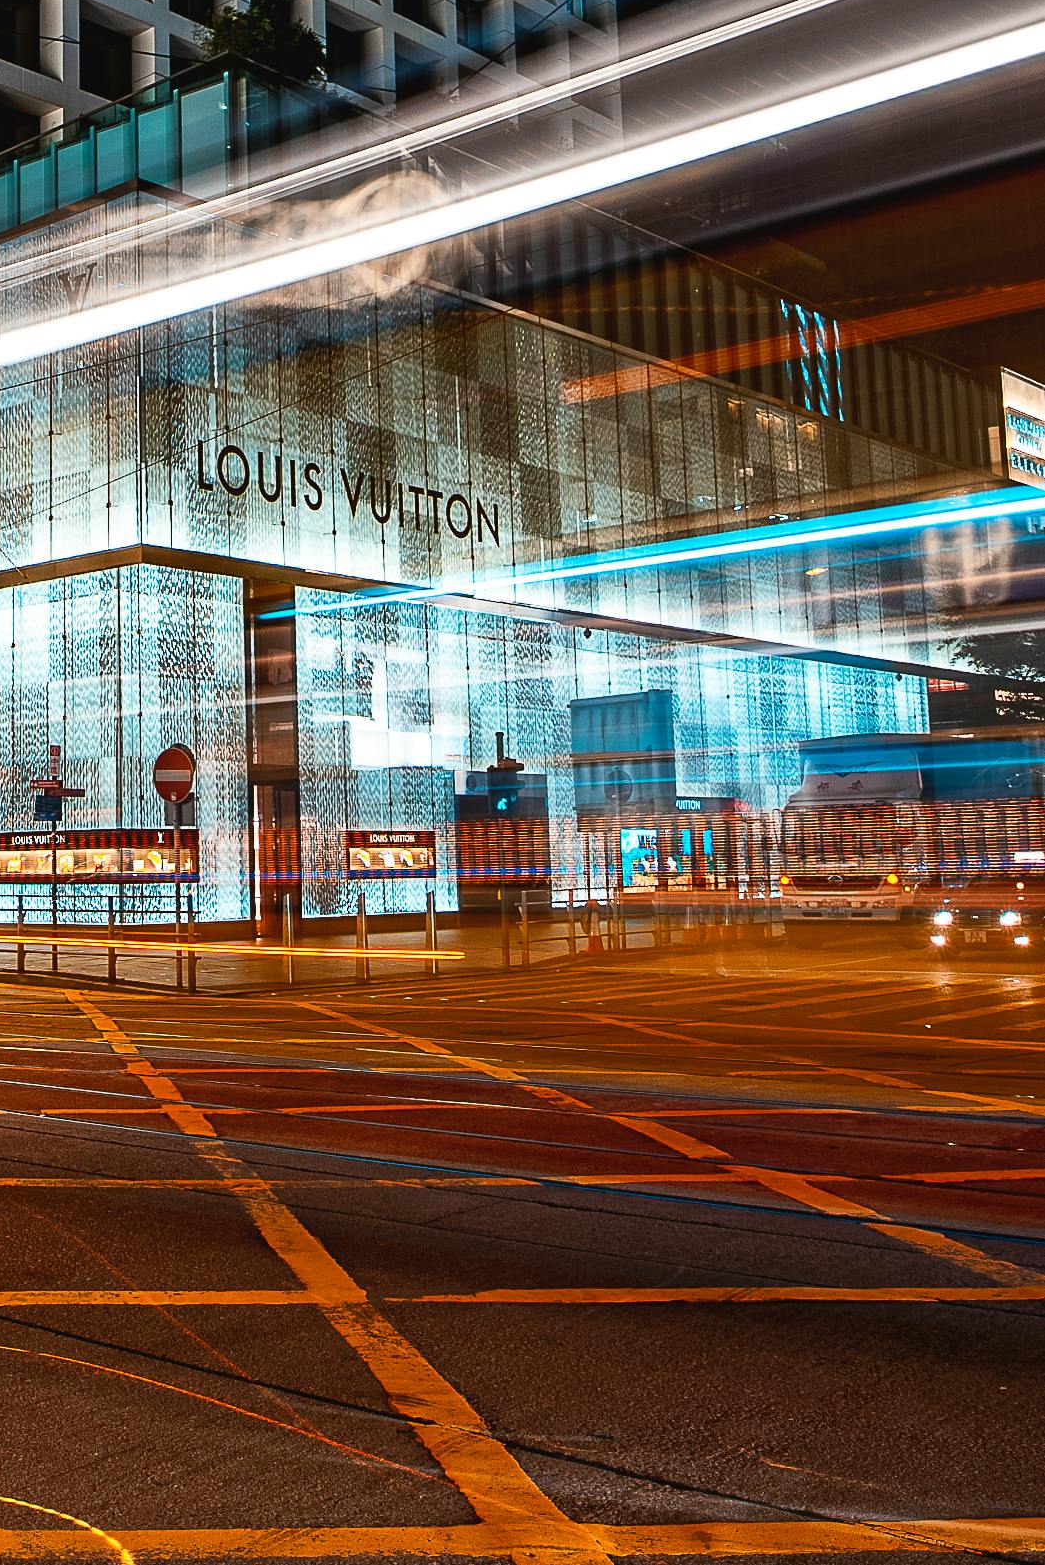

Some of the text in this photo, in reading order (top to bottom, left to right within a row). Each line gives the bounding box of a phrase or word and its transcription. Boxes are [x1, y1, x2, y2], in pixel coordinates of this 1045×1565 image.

[197, 440, 500, 548] LOUIS VUITTON
[10, 835, 33, 846] LOUIS
[369, 834, 415, 843] LOUIS VUITTON
